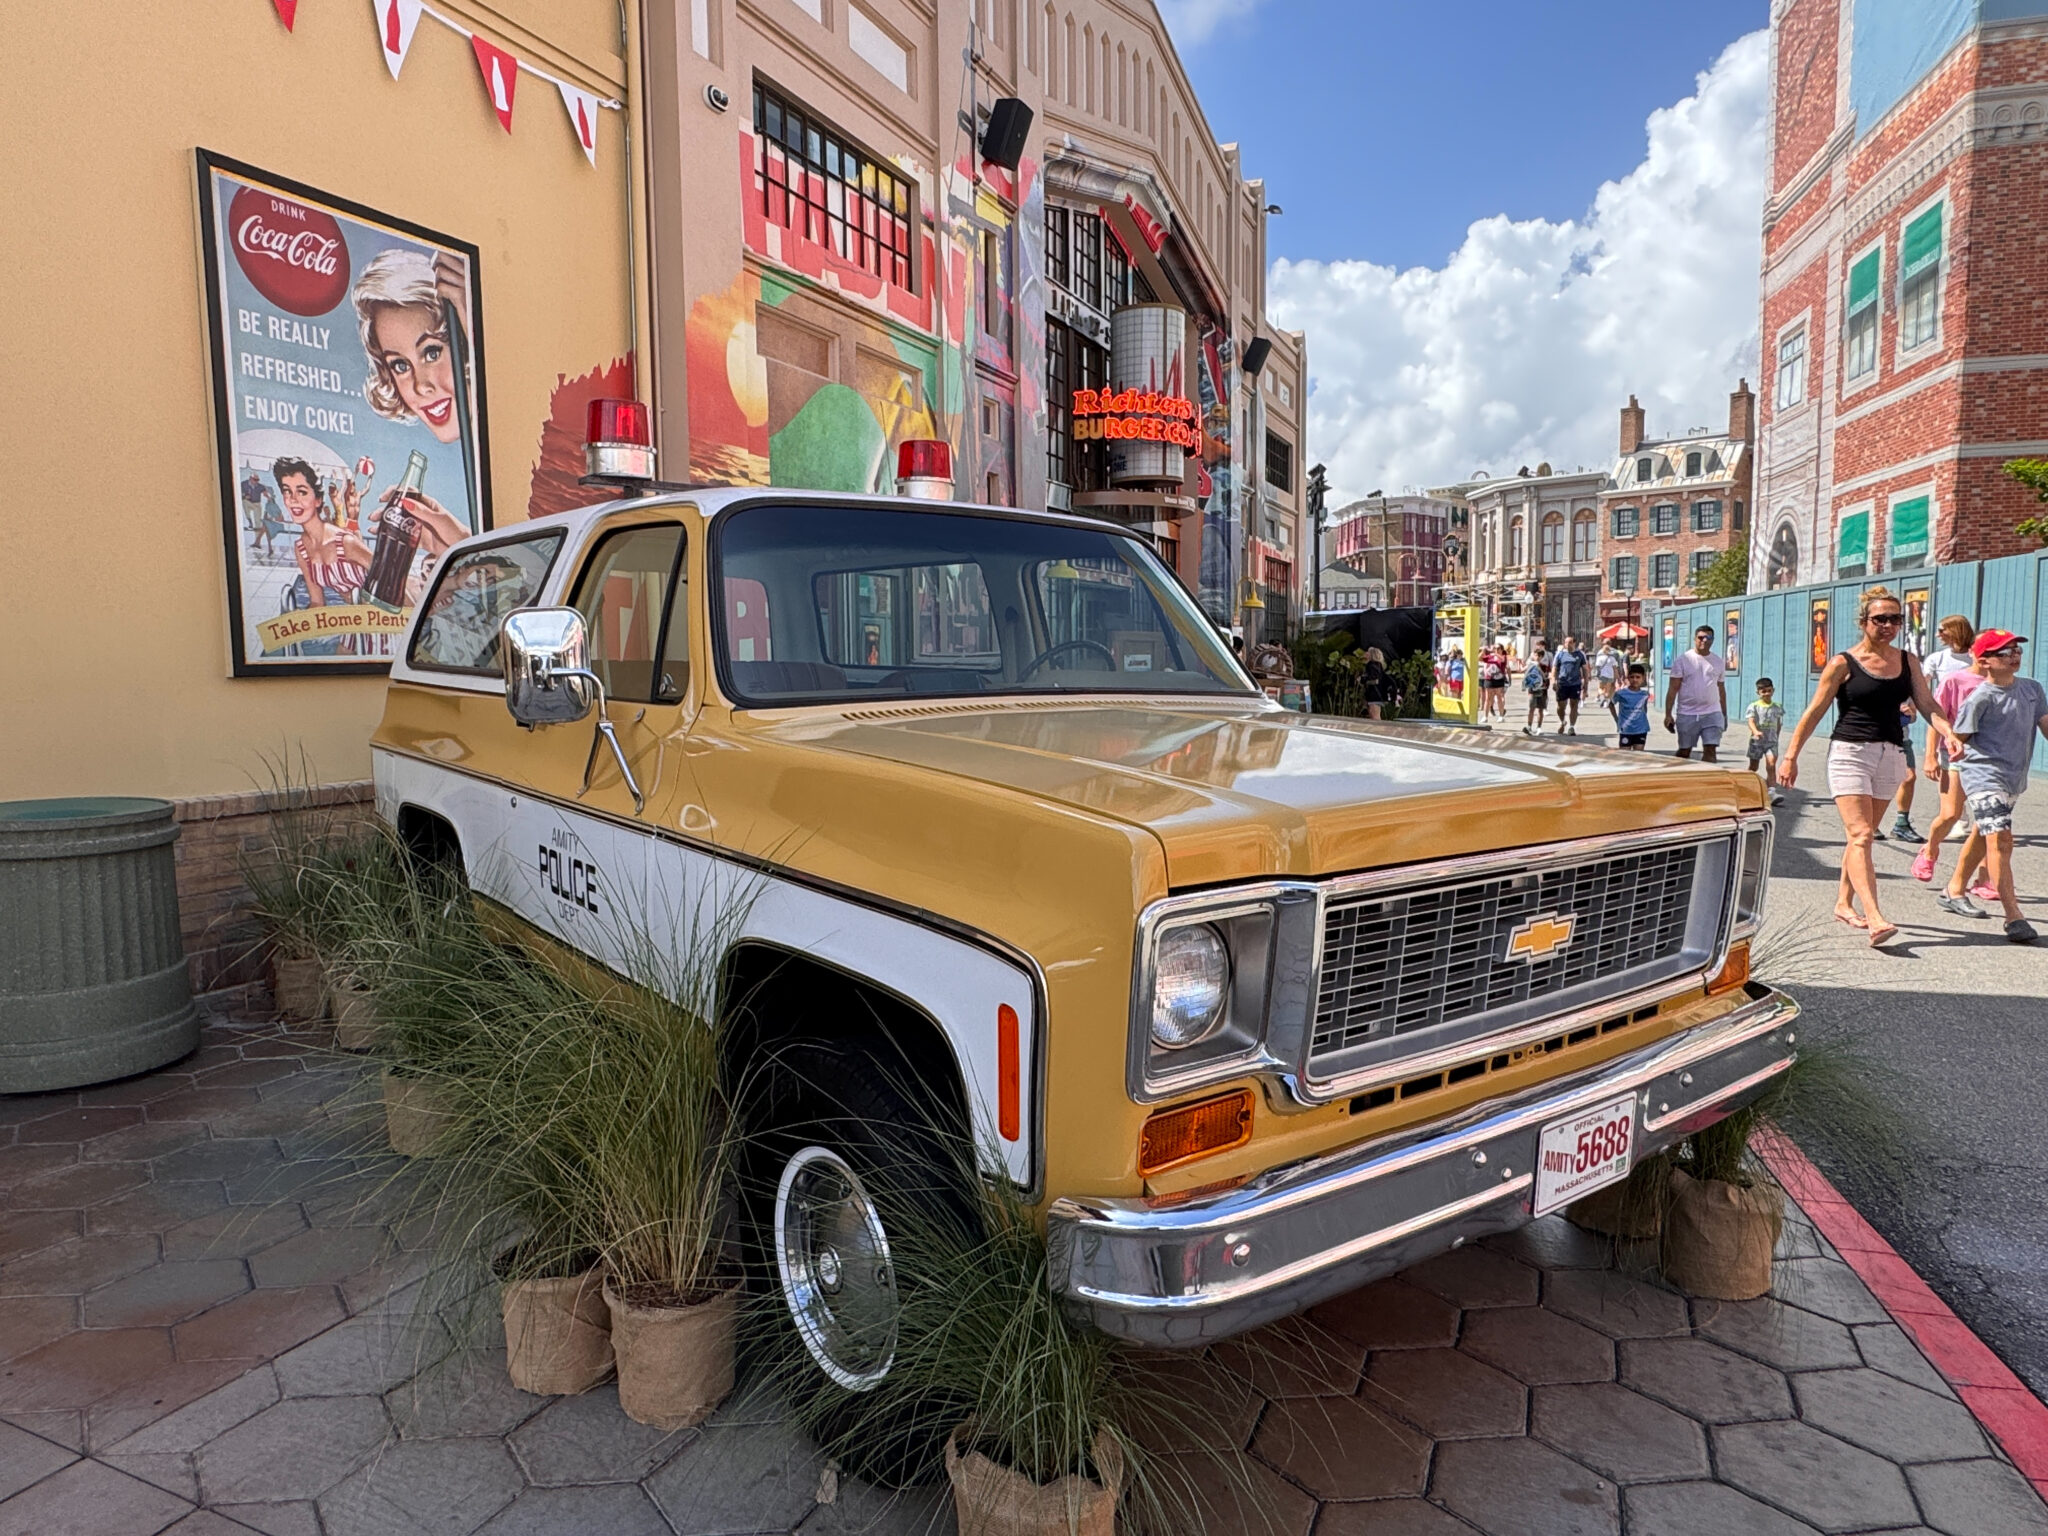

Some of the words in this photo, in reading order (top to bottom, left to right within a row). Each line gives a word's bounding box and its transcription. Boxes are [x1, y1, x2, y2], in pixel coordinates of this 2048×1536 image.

[271, 199, 306, 221] DRINK
[238, 308, 262, 336] BE
[268, 315, 330, 350] REALLY
[240, 352, 361, 397] REFRESHED...
[244, 395, 299, 426] ENJOY
[305, 406, 354, 436] COKE!
[1073, 416, 1167, 441] BURGER
[268, 615, 311, 641] Take
[315, 612, 362, 630] Home
[552, 827, 580, 854] AMITY
[539, 844, 598, 914] POLICE
[1574, 1114, 1605, 1132] OFFICIAL
[1543, 1150, 1576, 1175] AMITY
[1576, 1115, 1630, 1173] 5688
[1554, 1163, 1614, 1196] MASSACHUSETTS
